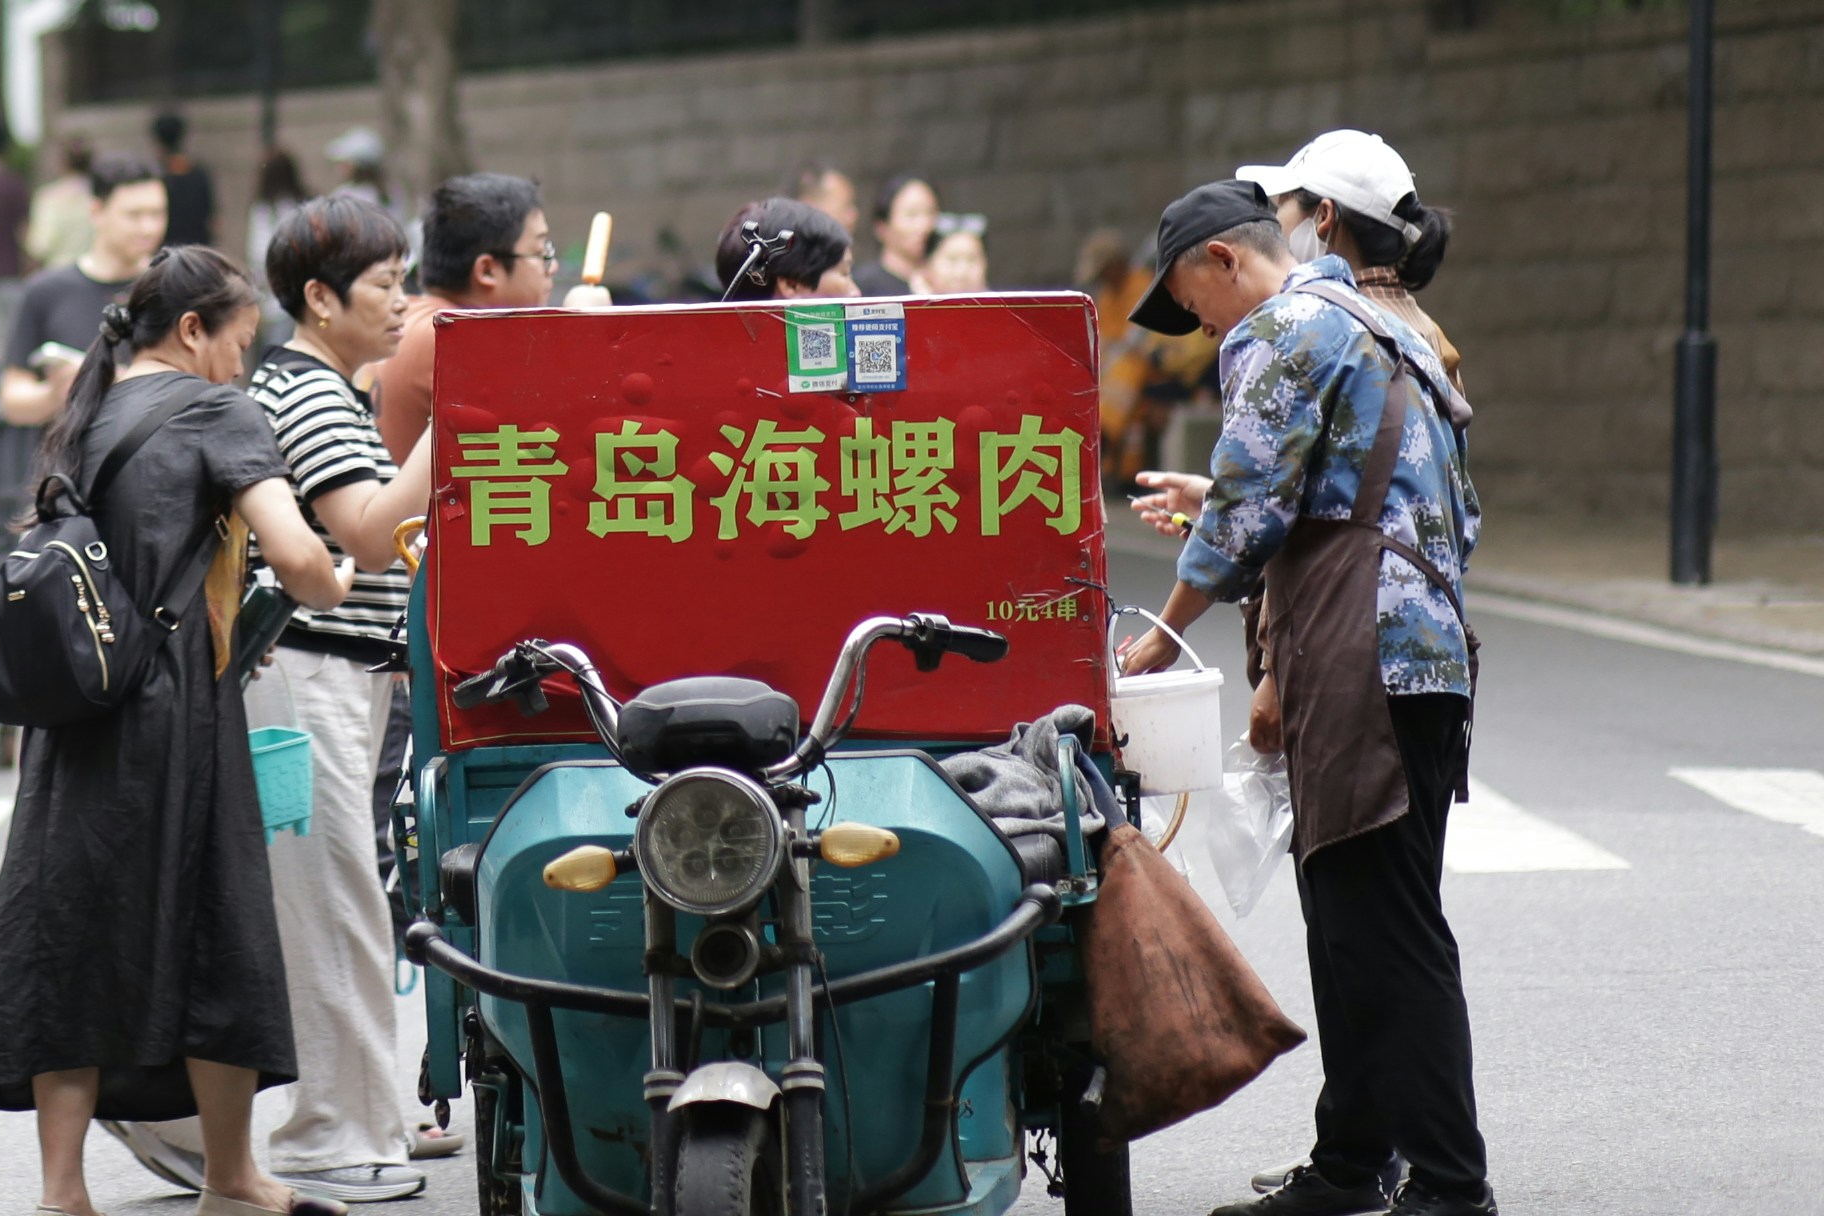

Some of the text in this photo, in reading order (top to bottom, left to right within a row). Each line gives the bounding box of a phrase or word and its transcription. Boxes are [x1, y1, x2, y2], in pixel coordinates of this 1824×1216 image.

[449, 414, 1084, 547] 青岛海螺肉
[986, 597, 1077, 622] 10元4串
